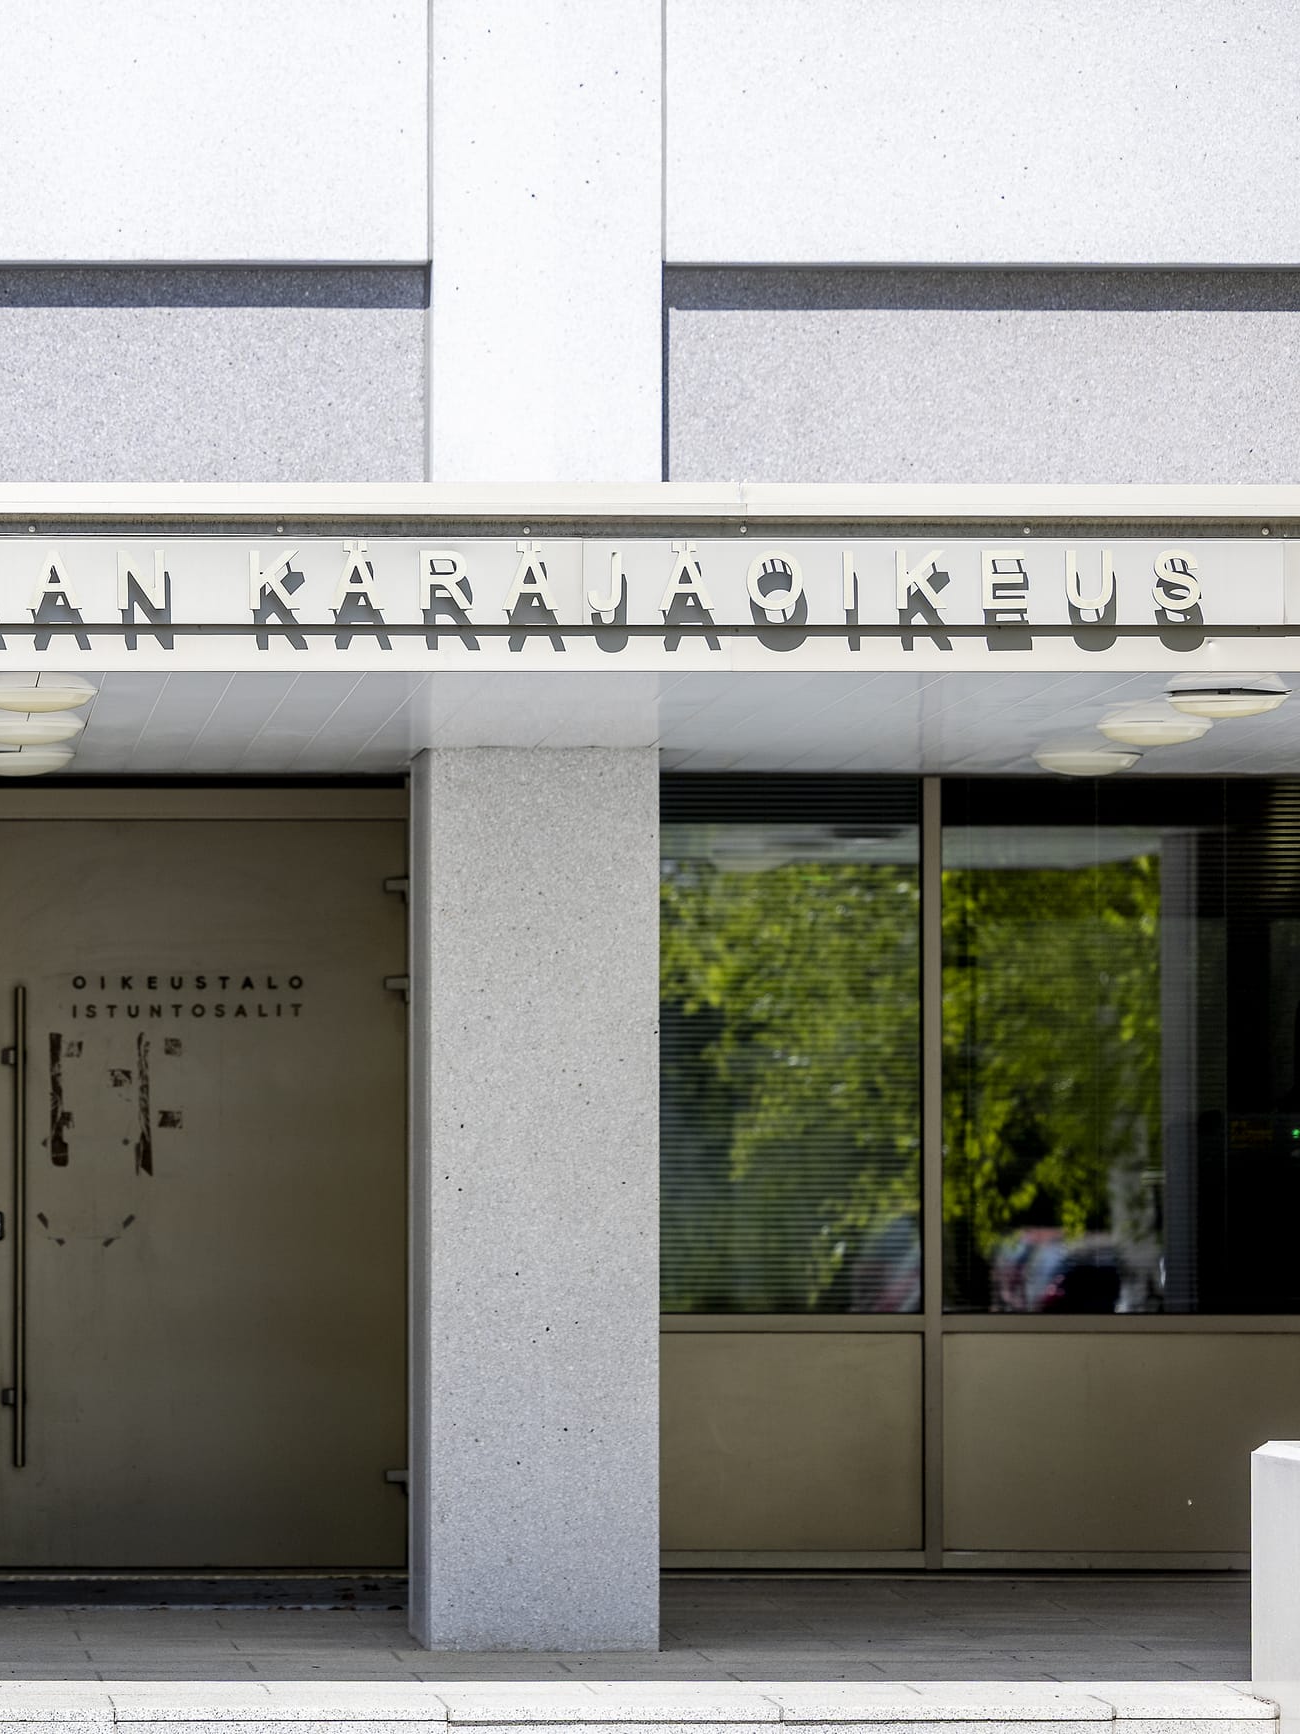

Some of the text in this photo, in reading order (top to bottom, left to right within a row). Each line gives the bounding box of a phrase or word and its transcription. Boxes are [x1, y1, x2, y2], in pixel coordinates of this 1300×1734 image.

[248, 540, 1202, 611] KÄRÄJÄOIKEUS
[72, 976, 304, 990] OIKEUSTALO
[72, 1004, 304, 1018] ISTUNTOSALIT
